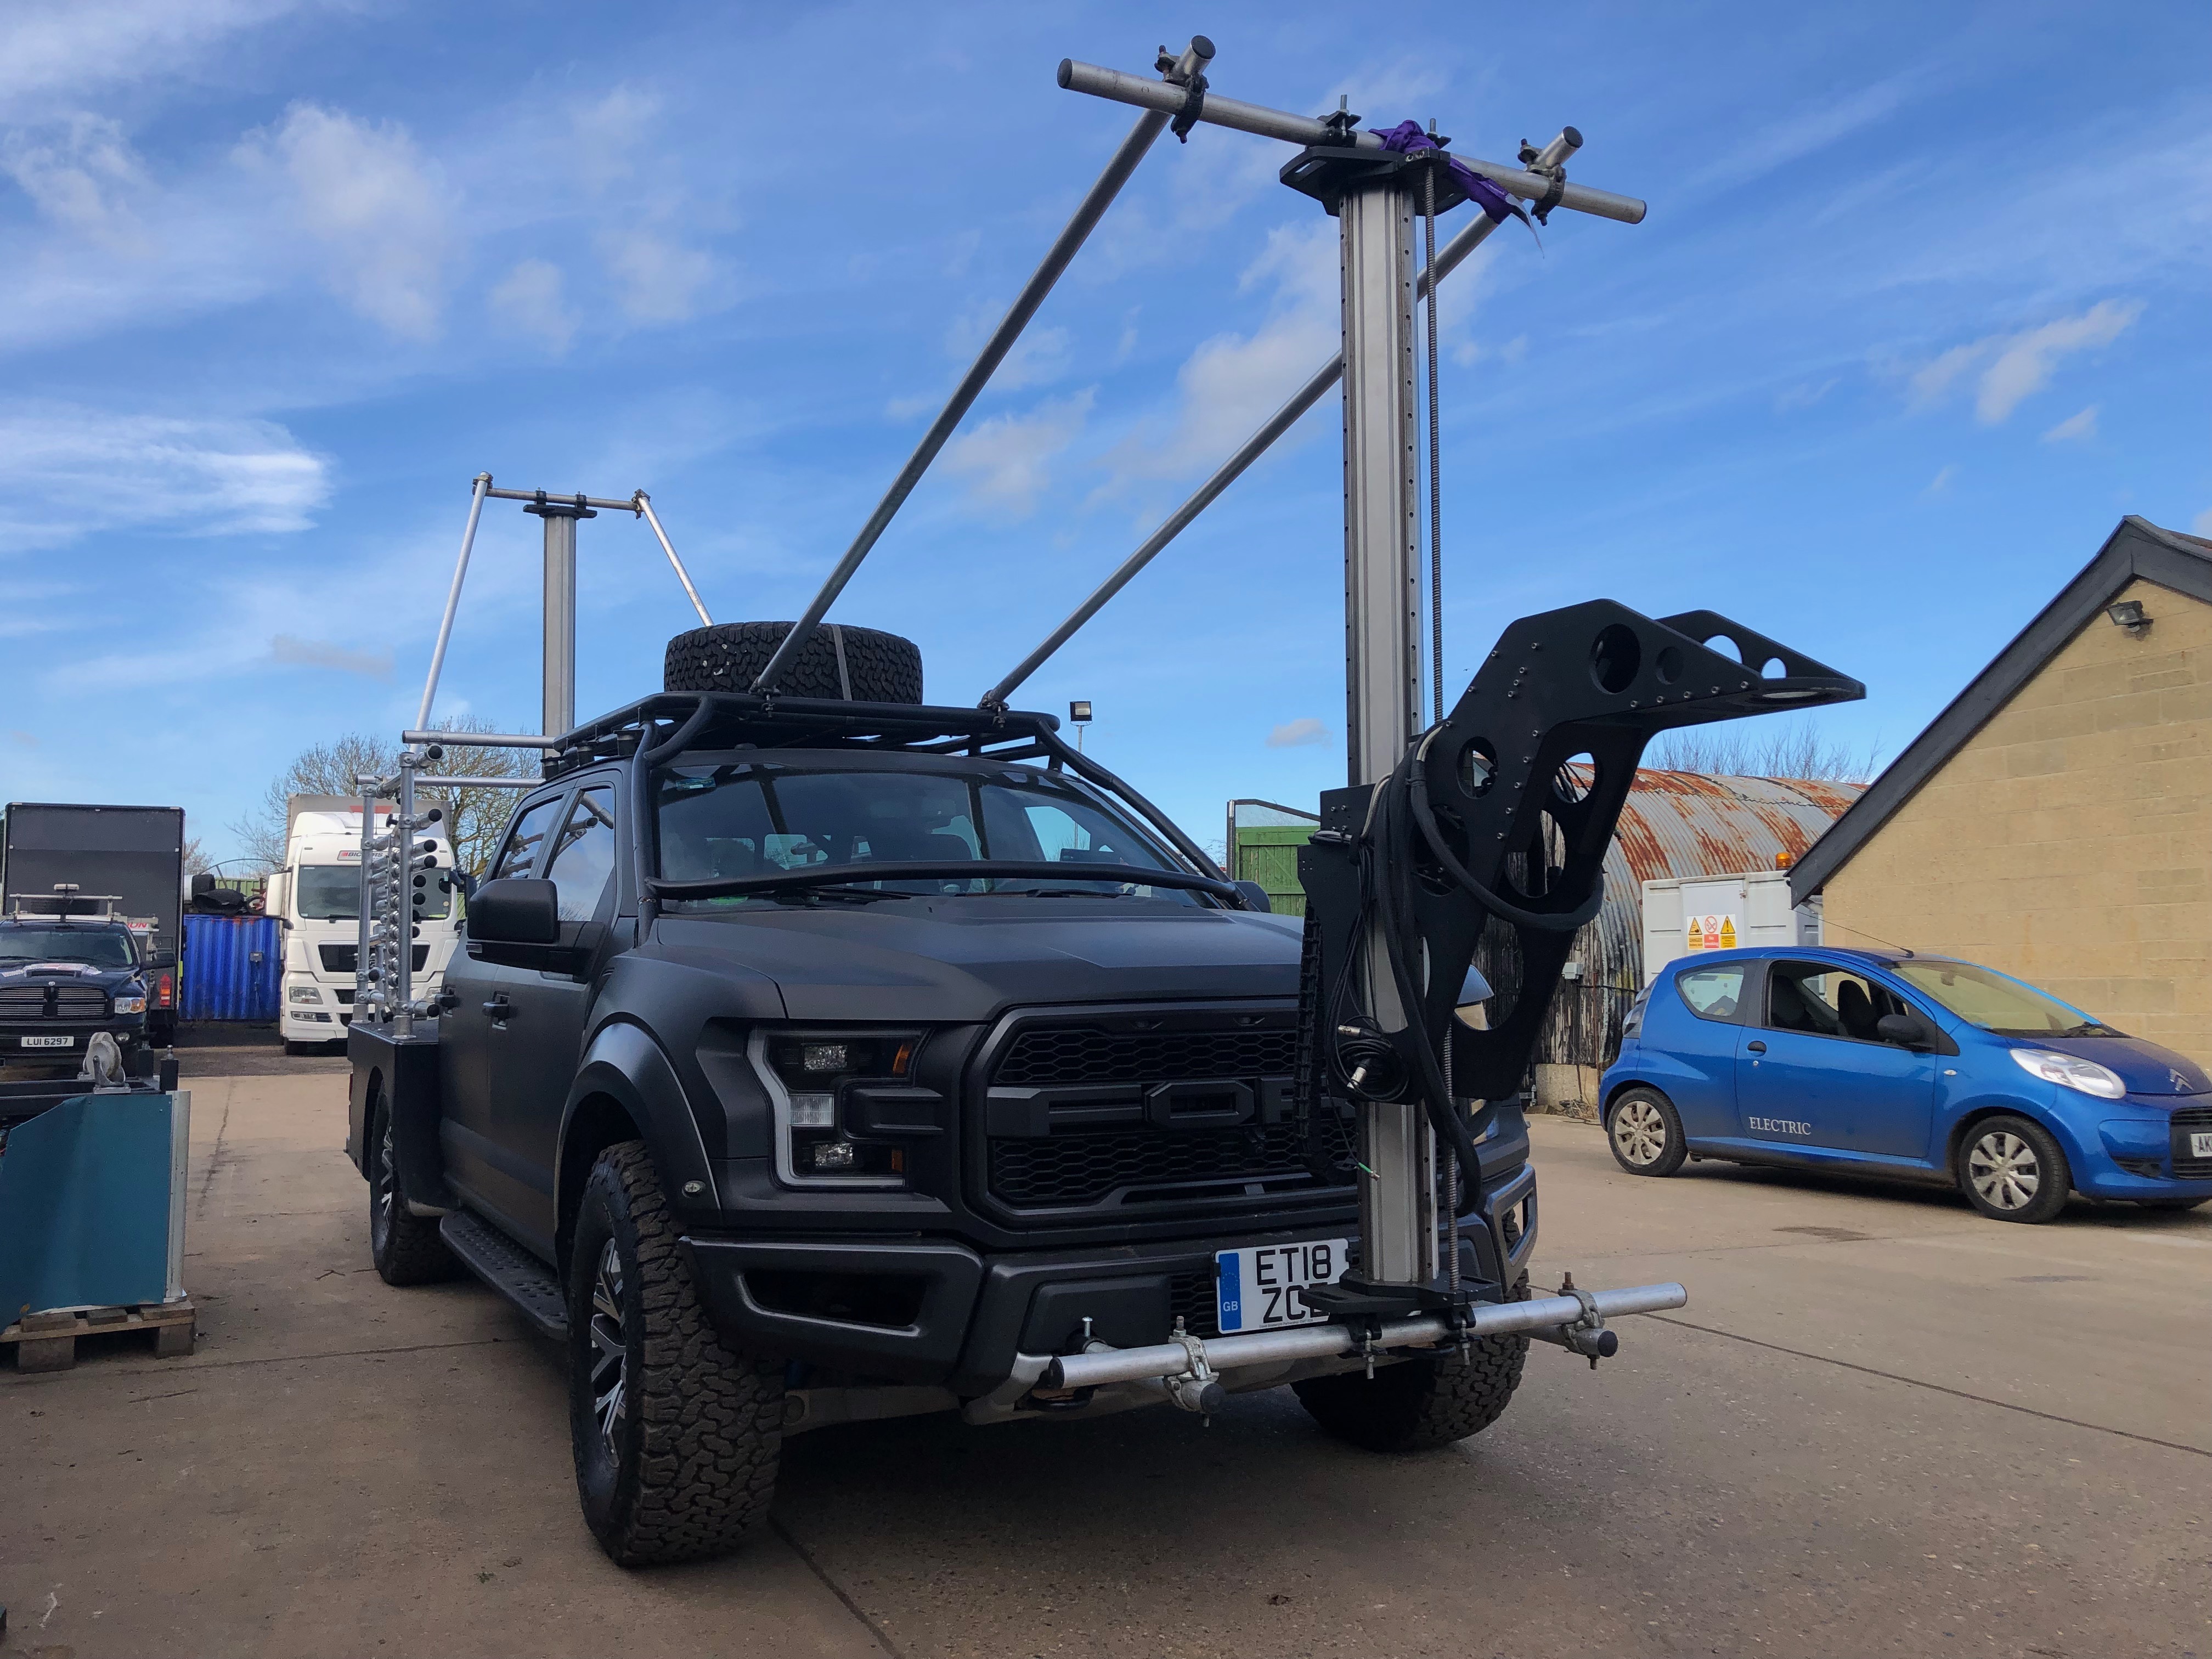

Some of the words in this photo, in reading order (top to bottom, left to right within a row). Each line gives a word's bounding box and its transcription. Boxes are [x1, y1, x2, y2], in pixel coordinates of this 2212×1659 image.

[44, 1037, 68, 1046] 6297
[1748, 1116, 1811, 1135] ELECTRIC
[1256, 1244, 1331, 1286] ET18
[1223, 1301, 1238, 1312] GB
